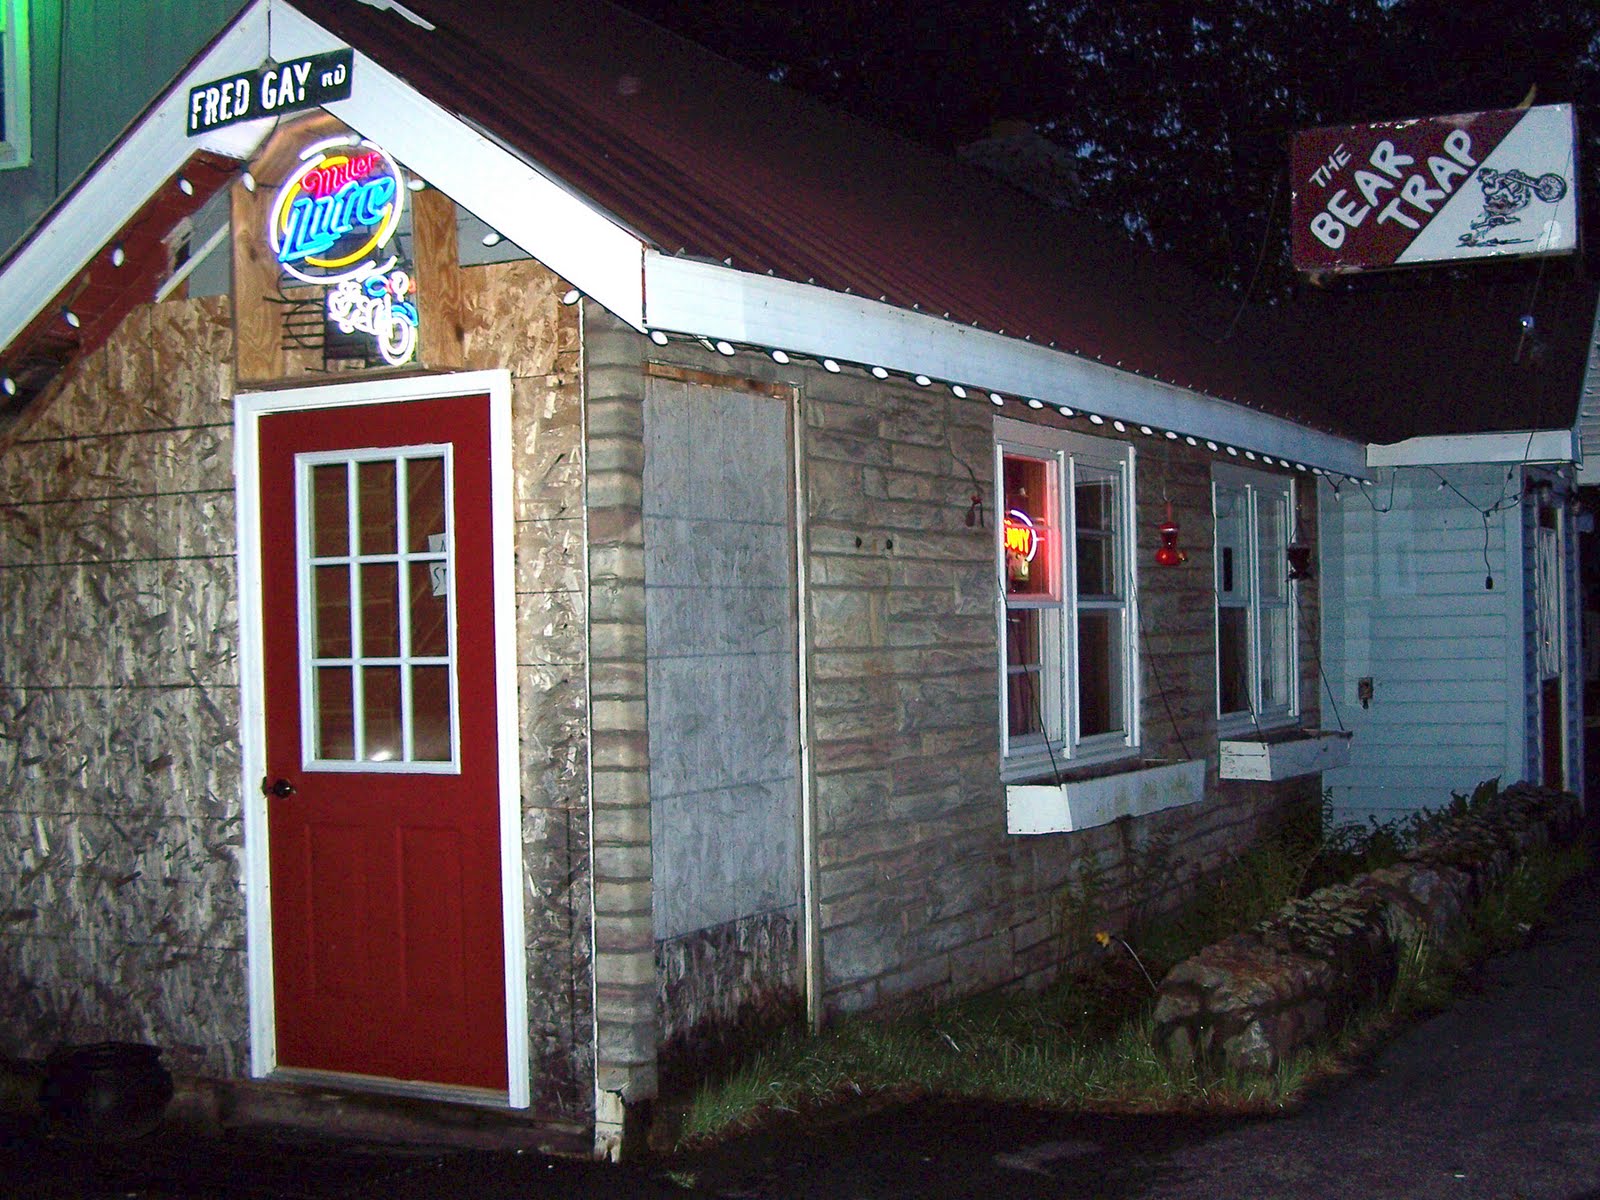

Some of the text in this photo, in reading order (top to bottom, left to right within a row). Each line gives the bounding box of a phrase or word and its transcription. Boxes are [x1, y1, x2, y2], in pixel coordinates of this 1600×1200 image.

[191, 61, 347, 130] FRED GAY RD
[301, 152, 381, 199] Miller
[1308, 143, 1352, 189] THE
[1309, 140, 1415, 250] BEAR
[1376, 129, 1477, 230] TRAP
